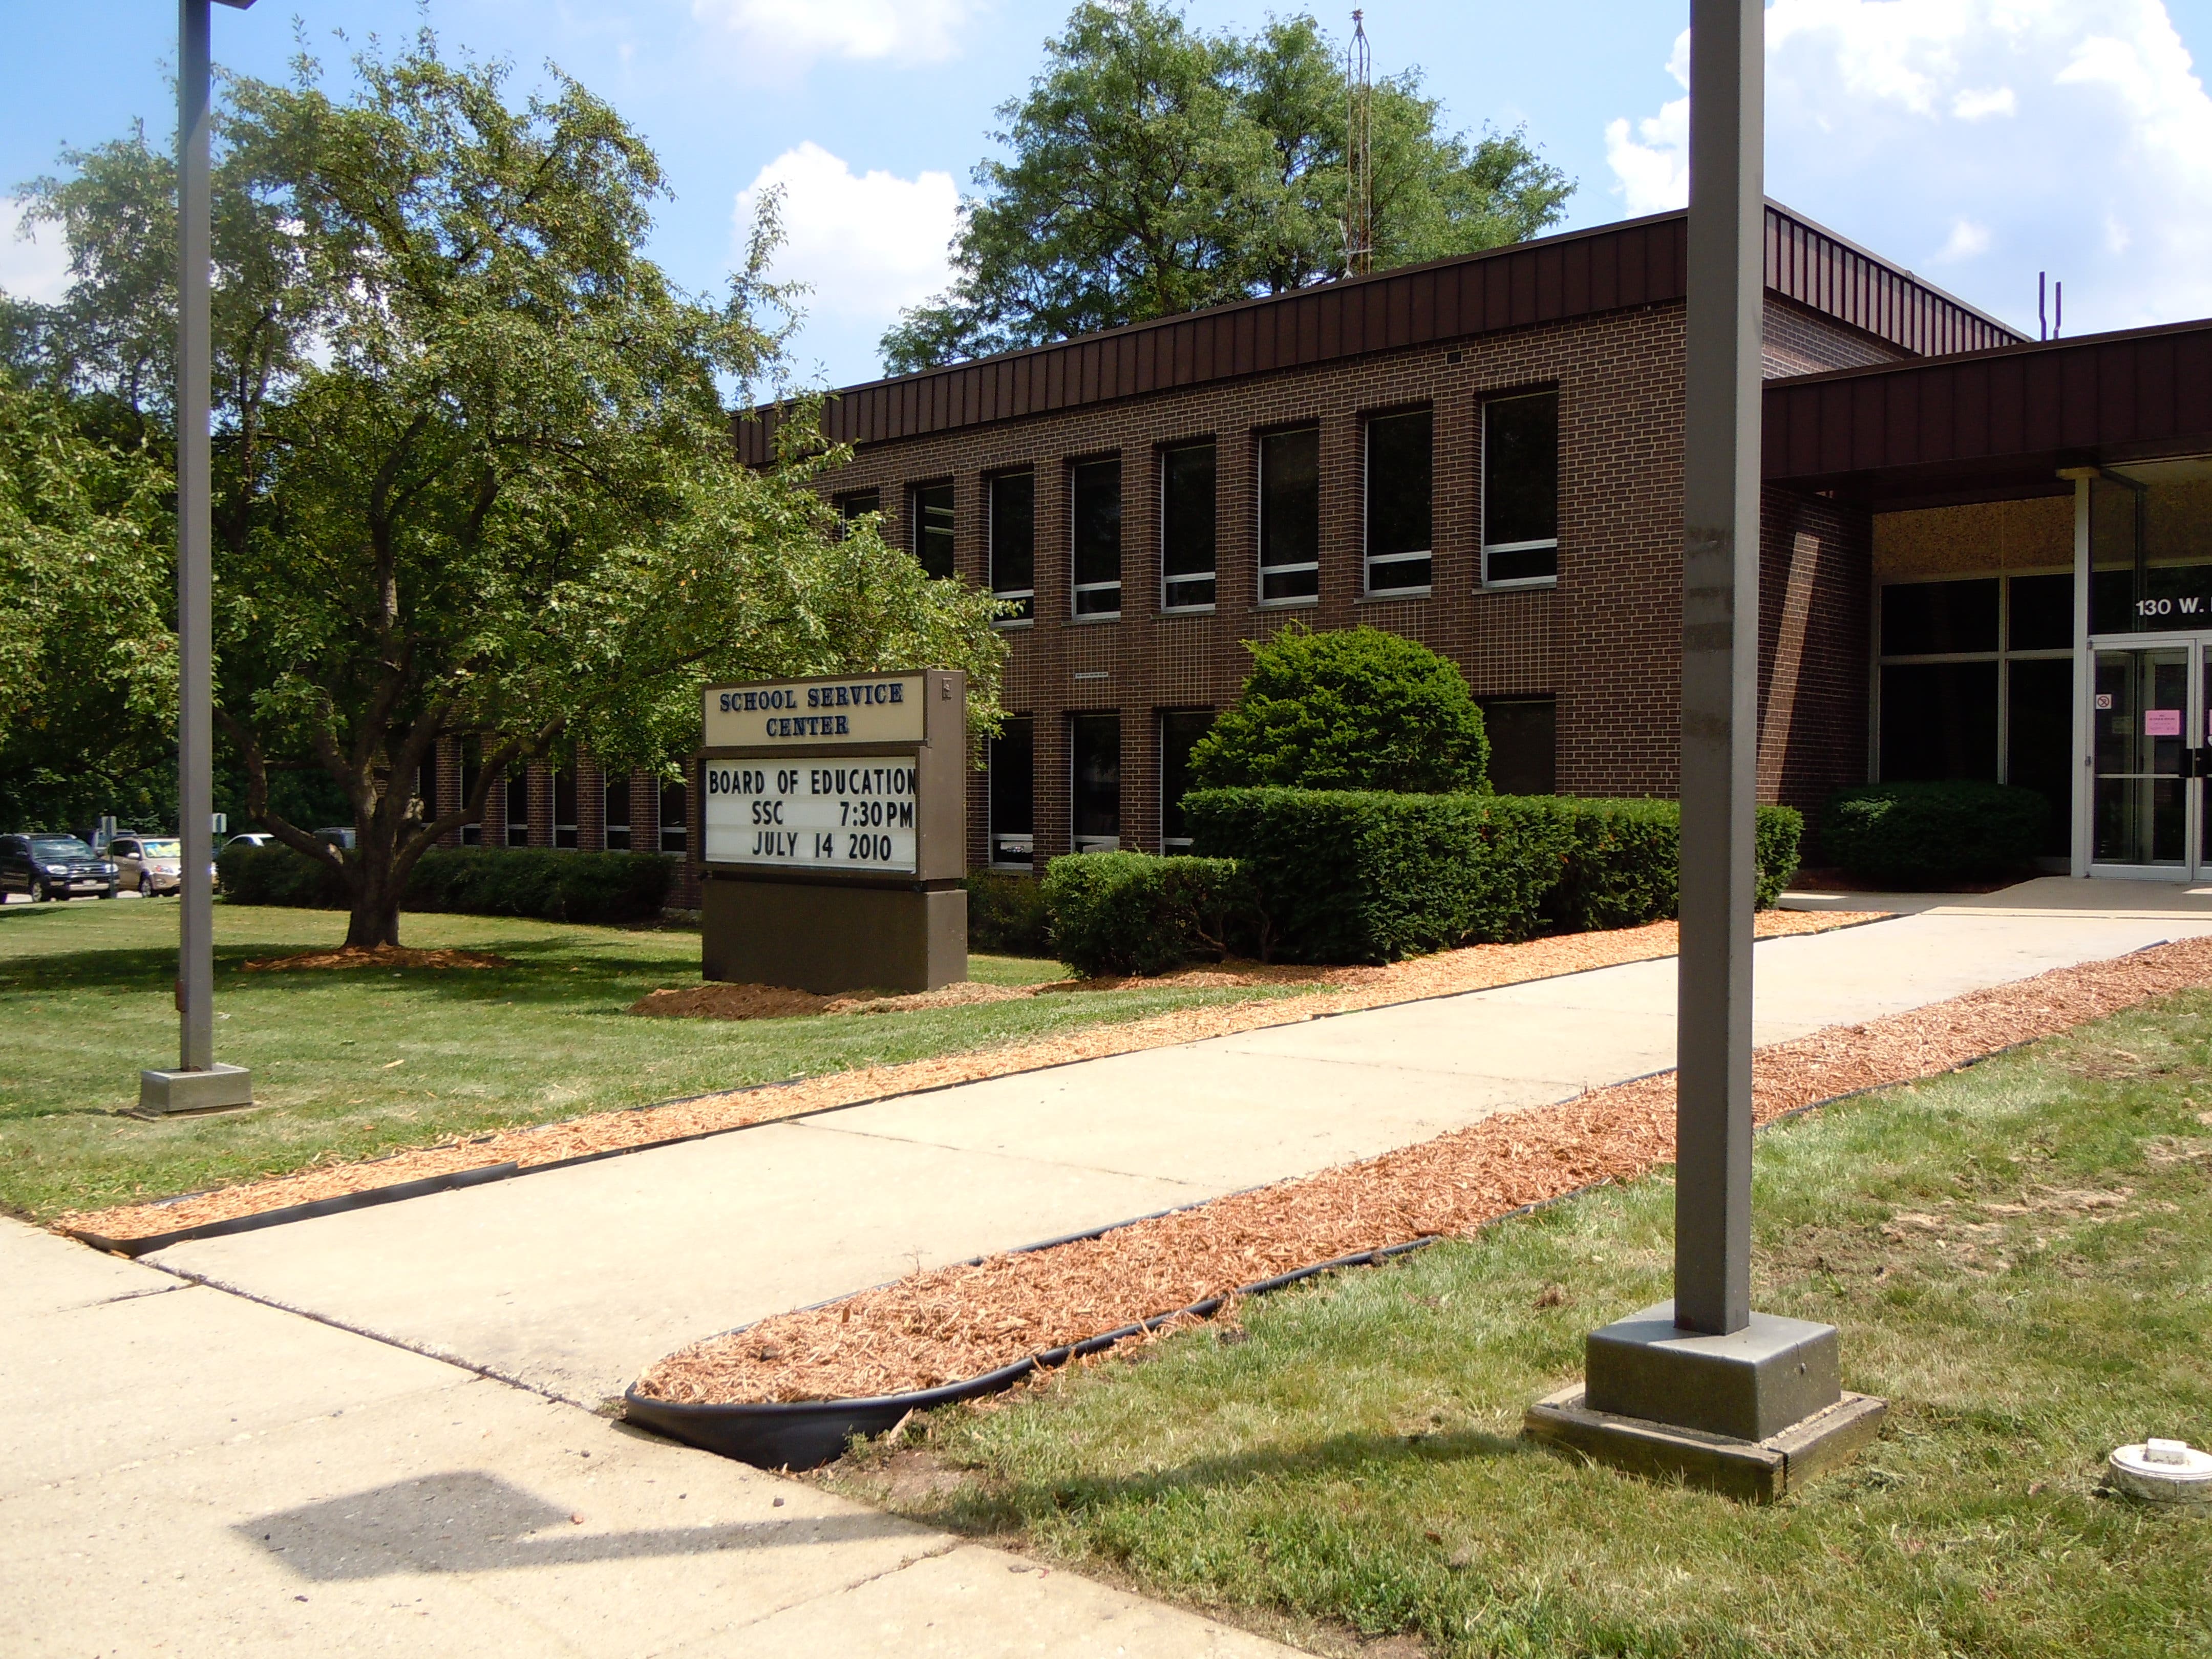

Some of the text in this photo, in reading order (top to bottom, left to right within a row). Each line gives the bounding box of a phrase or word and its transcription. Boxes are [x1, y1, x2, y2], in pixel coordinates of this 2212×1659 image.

[2136, 599, 2172, 615] 130
[2178, 597, 2204, 613] W.
[720, 683, 903, 712] SCHOOL SERVICE
[766, 715, 849, 736] CENTER
[709, 768, 916, 795] BOARD OF EDUCATION
[752, 800, 783, 825] SSC
[752, 831, 891, 861] JULY 14 2010
